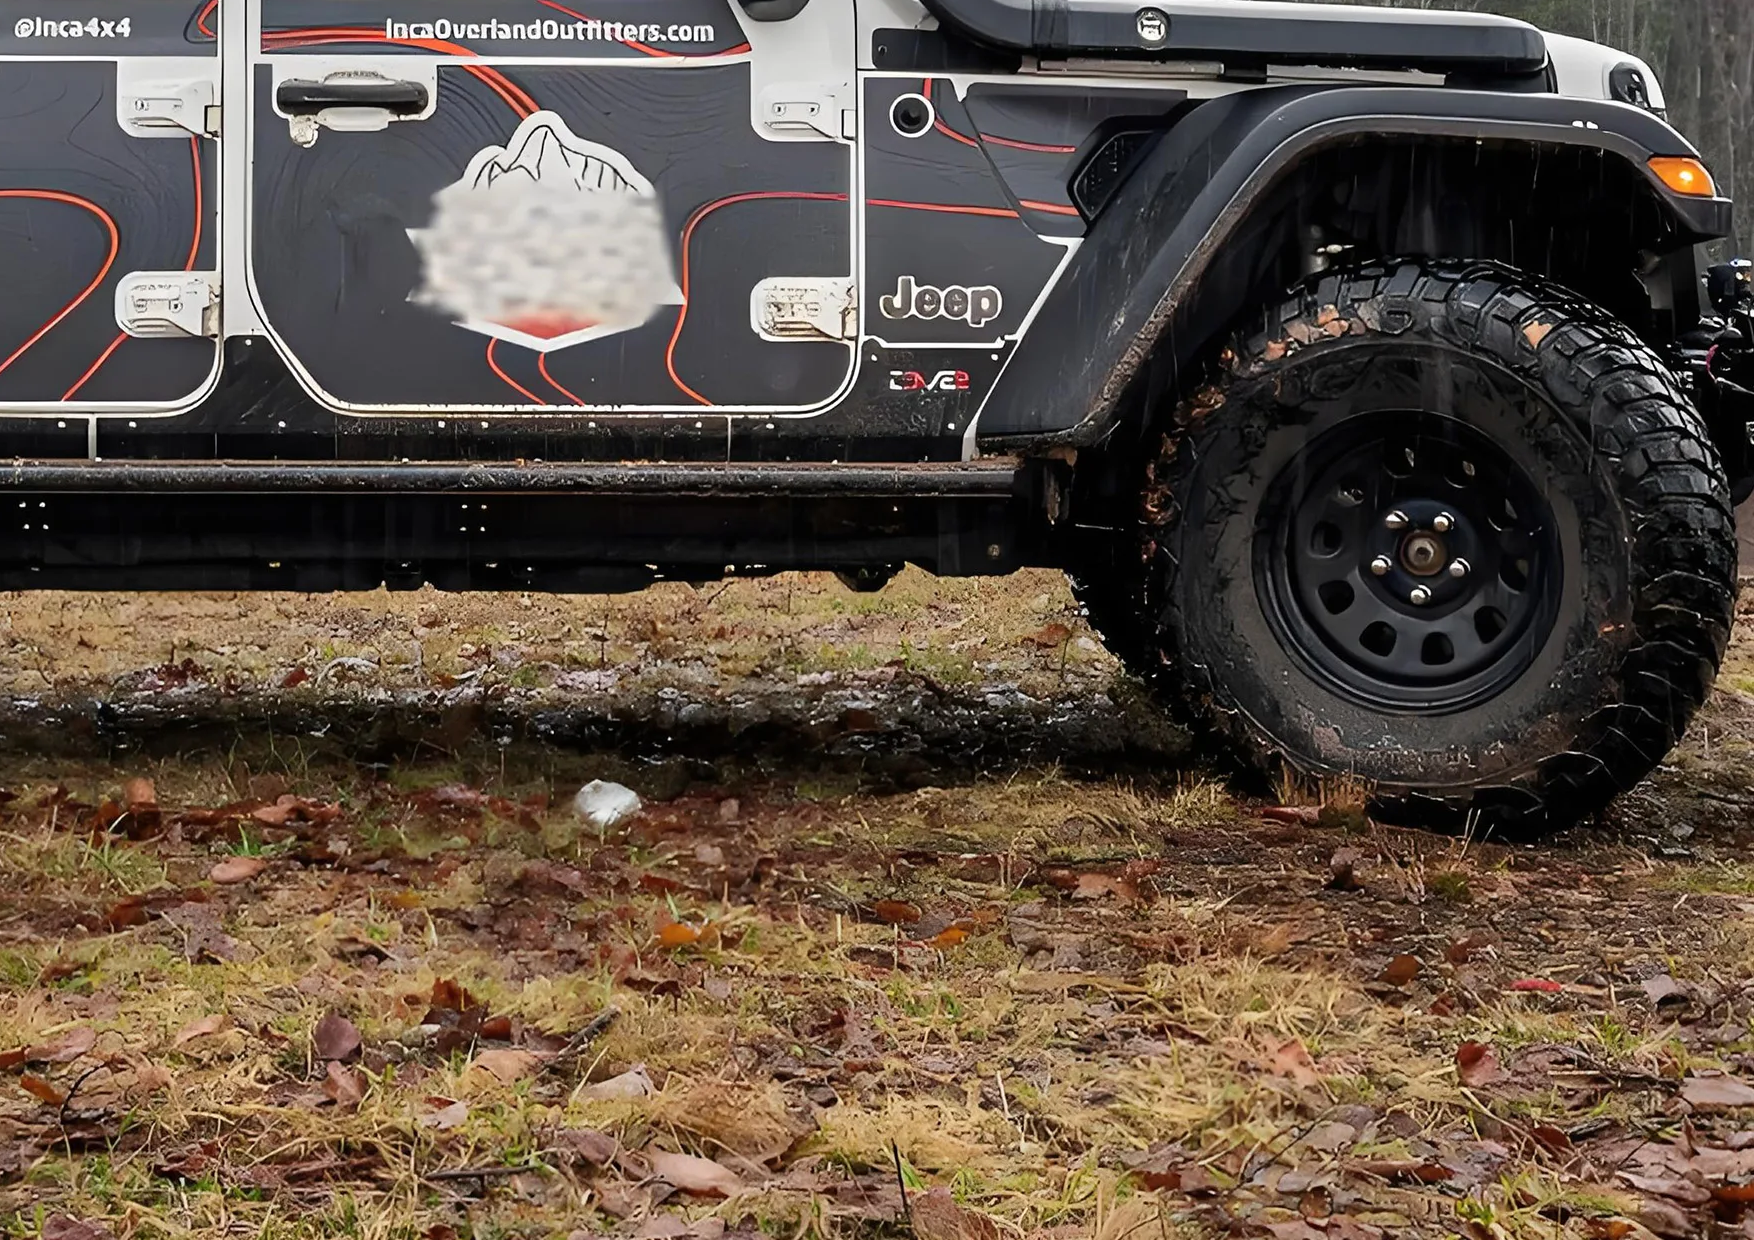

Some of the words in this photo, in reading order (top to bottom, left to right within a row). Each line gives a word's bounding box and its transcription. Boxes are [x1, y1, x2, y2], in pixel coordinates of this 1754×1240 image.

[14, 16, 131, 38] @Inca4x4
[386, 18, 715, 42] IncaOverlandOutfitters.com
[879, 275, 1003, 328] Jeep
